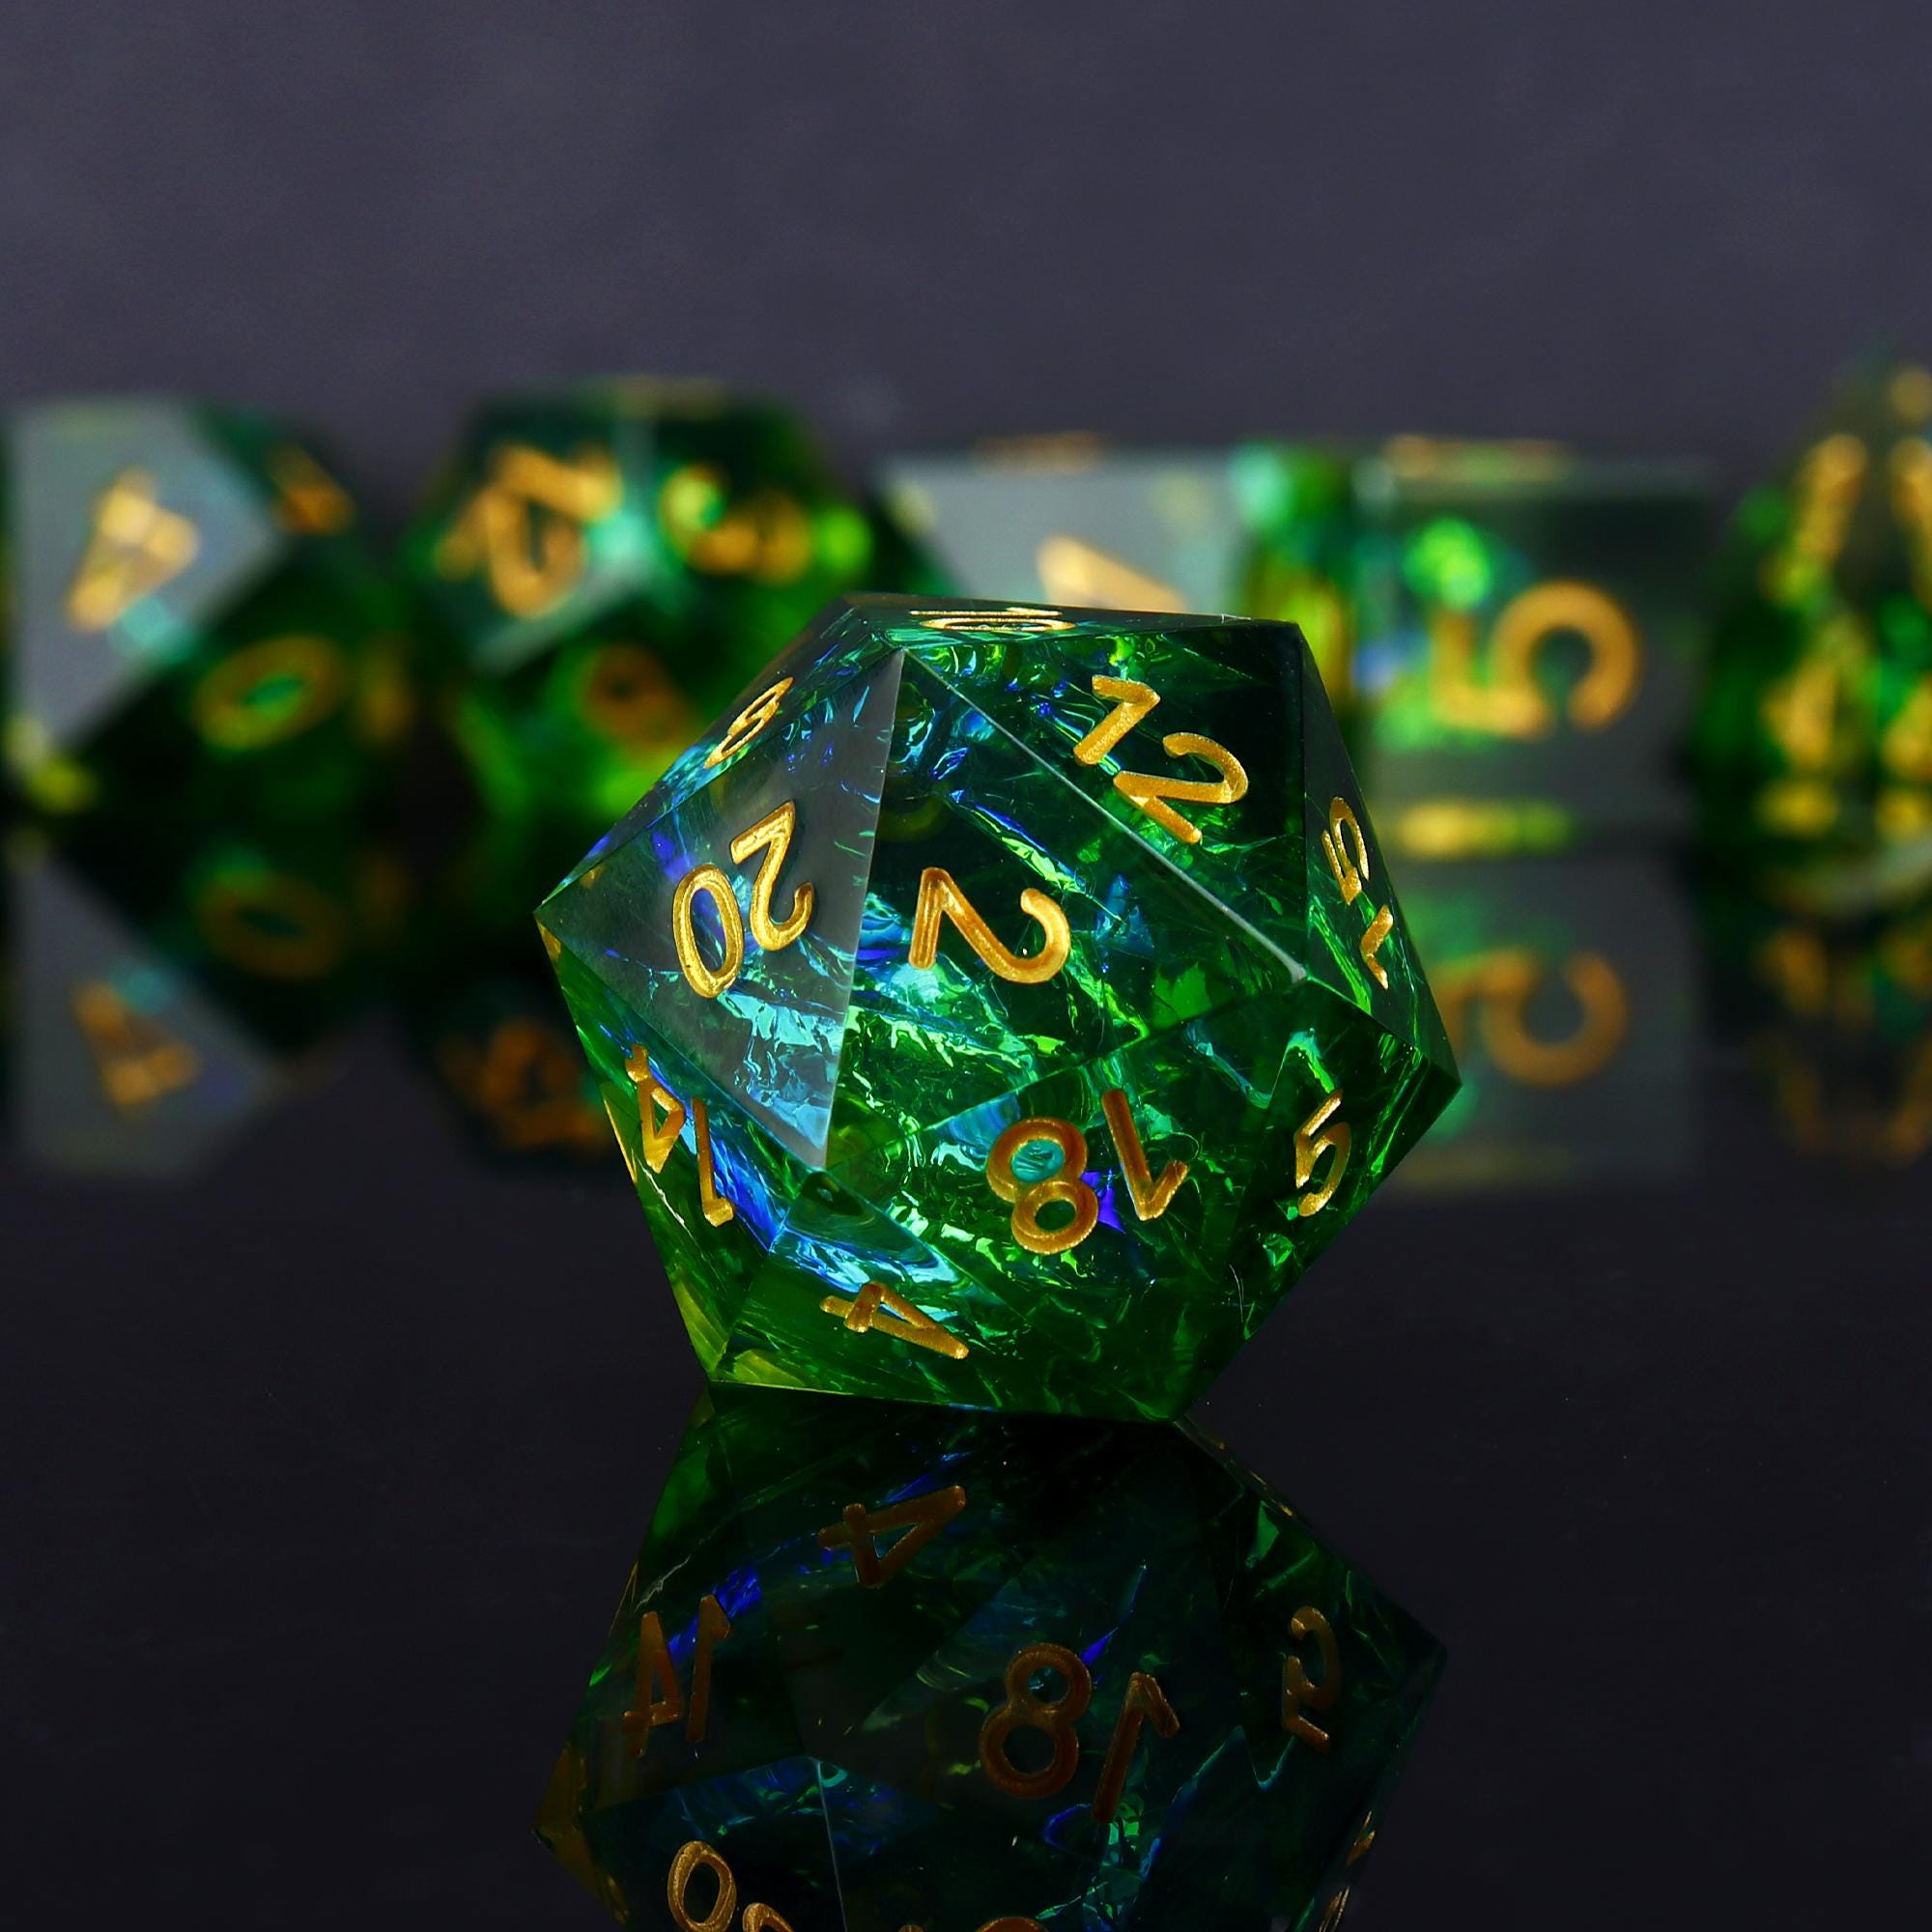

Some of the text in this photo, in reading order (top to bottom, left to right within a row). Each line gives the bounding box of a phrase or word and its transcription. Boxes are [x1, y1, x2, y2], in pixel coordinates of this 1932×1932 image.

[909, 607, 1077, 633] 10
[703, 676, 794, 769] 8
[1073, 674, 1249, 844] 12
[672, 800, 814, 999] 20
[908, 867, 1071, 984] 2
[1321, 796, 1394, 990] 15
[624, 1043, 735, 1227] 14
[985, 1088, 1190, 1256] 18
[1293, 1089, 1352, 1218] 5
[819, 1281, 970, 1360] 4
